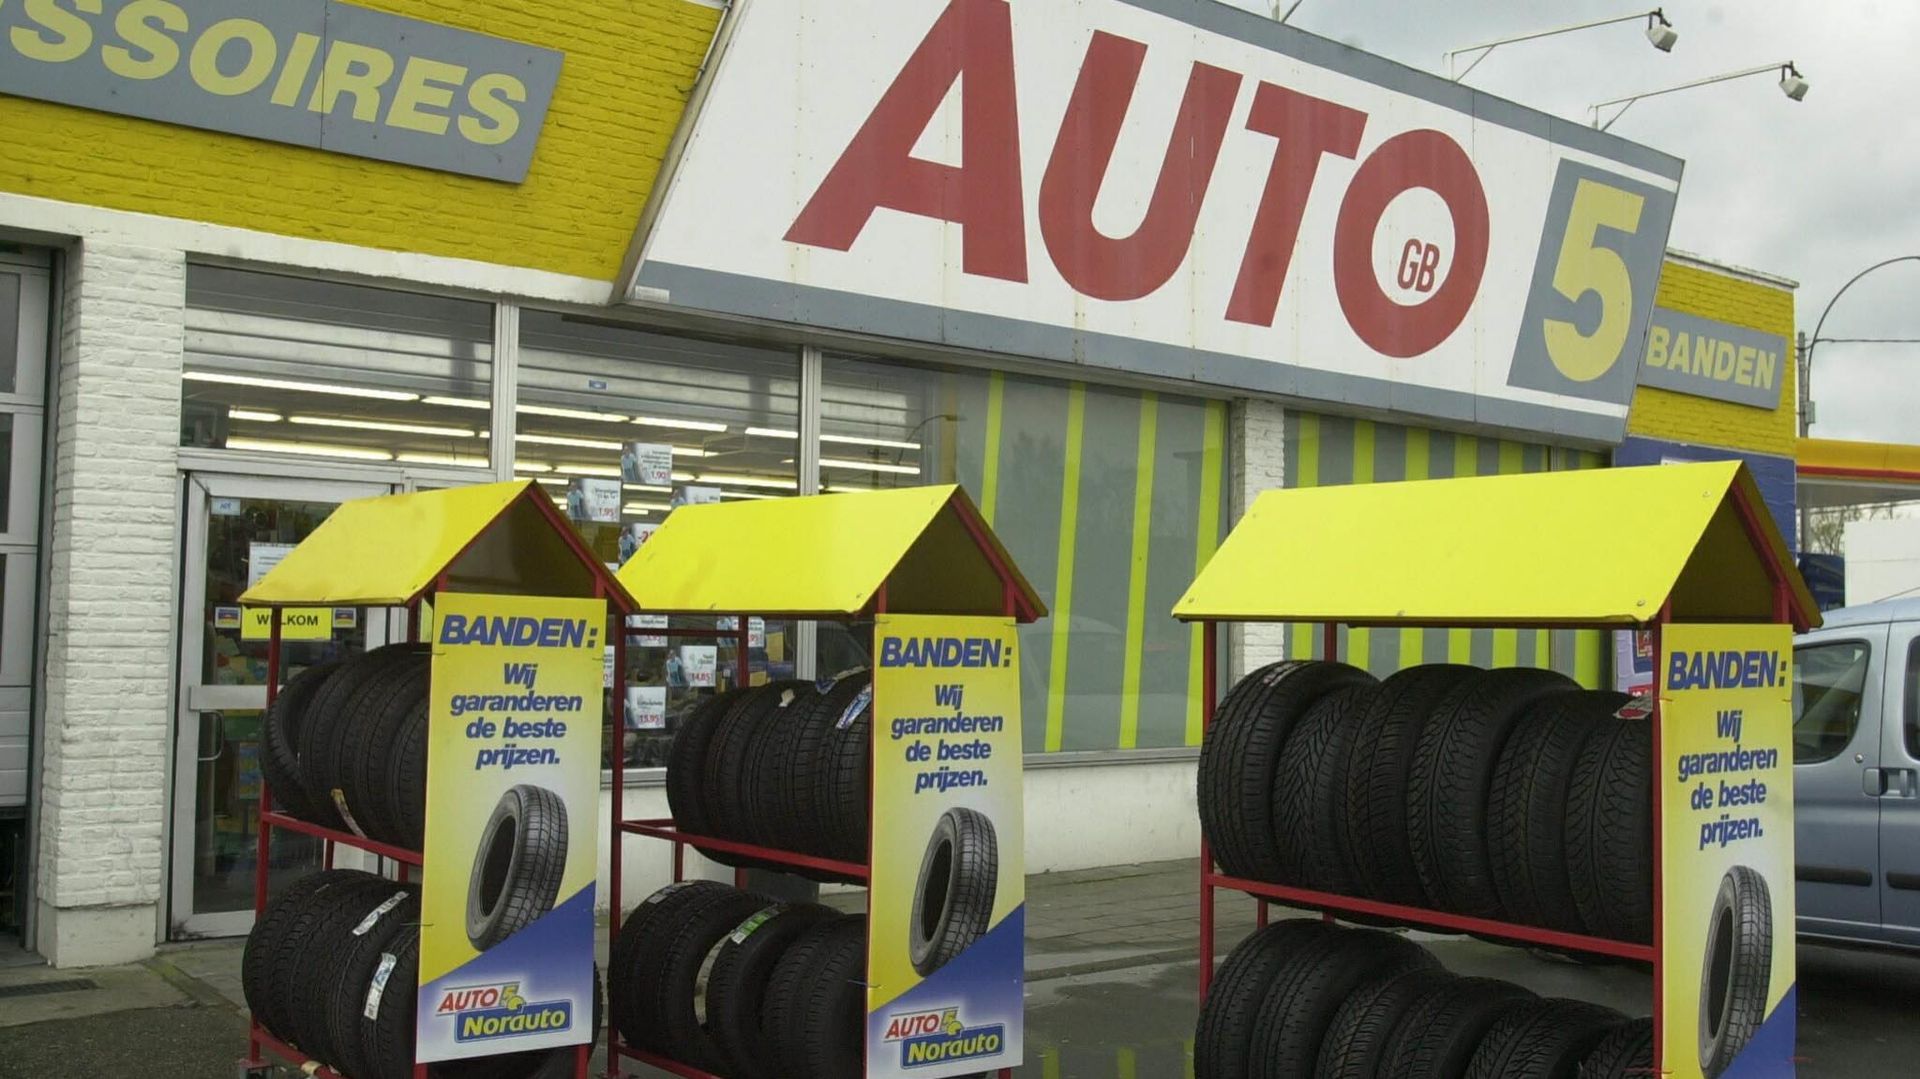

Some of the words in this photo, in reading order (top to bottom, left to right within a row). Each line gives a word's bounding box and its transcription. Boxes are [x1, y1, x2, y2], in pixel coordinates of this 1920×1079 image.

[0, 0, 527, 146] SSOIRES
[782, 0, 1491, 359] AUTO
[1543, 178, 1645, 383] 5
[1397, 237, 1441, 294] GB
[1645, 325, 1776, 390] BANDEN
[257, 614, 319, 627] WKOM
[439, 614, 598, 648] BANDEN:
[879, 636, 1012, 668] BANDEN:
[504, 663, 538, 689] Wij
[1667, 651, 1787, 690] BANDEN:
[450, 690, 582, 716] garanderen
[935, 684, 964, 710] Wij
[466, 717, 496, 738] de
[502, 717, 567, 738] beste
[891, 712, 1003, 740] garanderen
[1716, 710, 1742, 743] Wij
[475, 743, 560, 770] prijzen.
[905, 740, 931, 762] de
[937, 739, 991, 761] beste
[1678, 744, 1777, 782] garanderen
[915, 766, 988, 794] prijzen.
[1691, 782, 1713, 810] de
[1718, 779, 1767, 808] beste
[1700, 814, 1763, 850] prijzen.
[438, 987, 499, 1012] AUTO
[463, 1008, 566, 1038] Norauto
[885, 1014, 939, 1039] AUTO
[907, 1033, 999, 1063] Norauto
